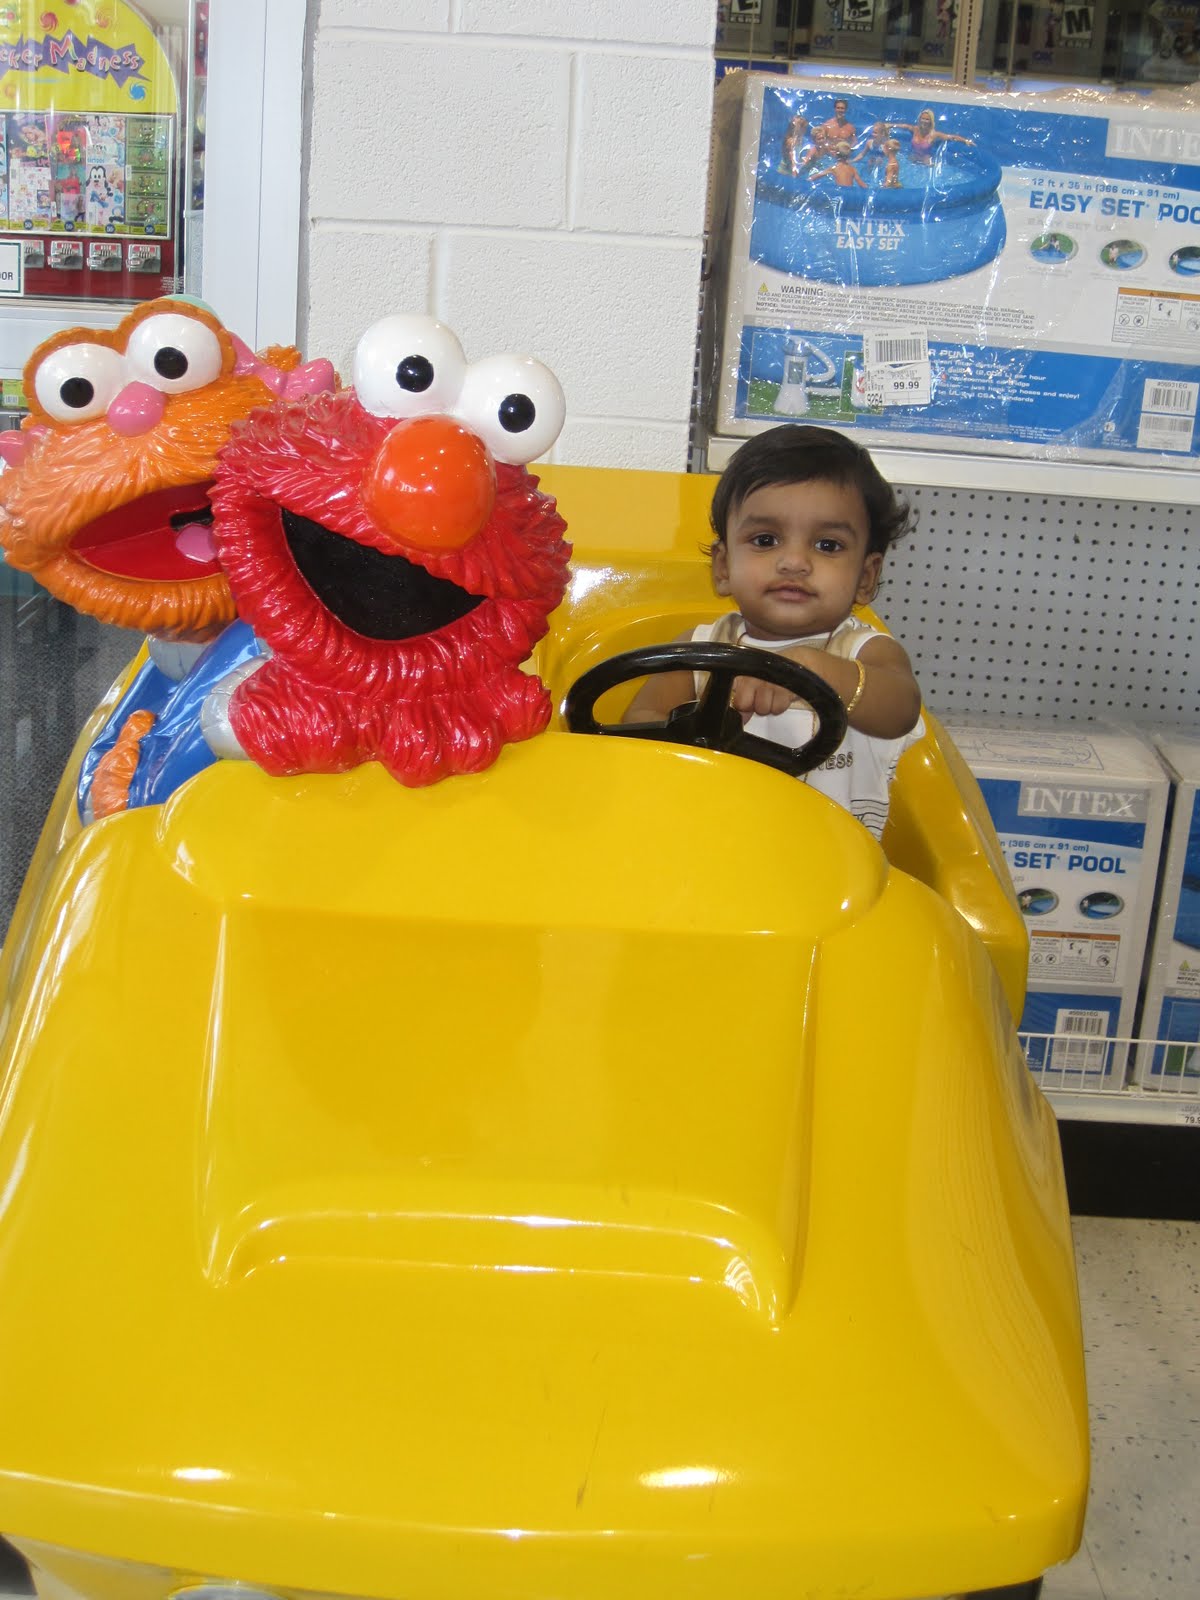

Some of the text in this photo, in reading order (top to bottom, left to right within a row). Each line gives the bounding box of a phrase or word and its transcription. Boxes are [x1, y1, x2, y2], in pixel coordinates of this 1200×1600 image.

[1065, 8, 1091, 35] M
[50, 33, 139, 71] Madness
[1032, 178, 1044, 186] 12
[1095, 184, 1118, 193] (366
[1147, 189, 1160, 197] 91
[1162, 192, 1180, 200] cm)
[1029, 190, 1093, 213] EASY
[1101, 198, 1146, 218] SET
[834, 217, 906, 237] INTEX
[837, 236, 901, 250] EASY SET
[0, 271, 14, 281] OR
[781, 285, 826, 296] WARNING:
[939, 349, 975, 359] PUMP
[893, 381, 920, 390] 99.99
[1023, 787, 1139, 818] INTEX
[1008, 839, 1031, 848] (366
[1058, 842, 1070, 850] 91
[1073, 844, 1090, 852] cm)
[1014, 851, 1126, 874] SET POOL
